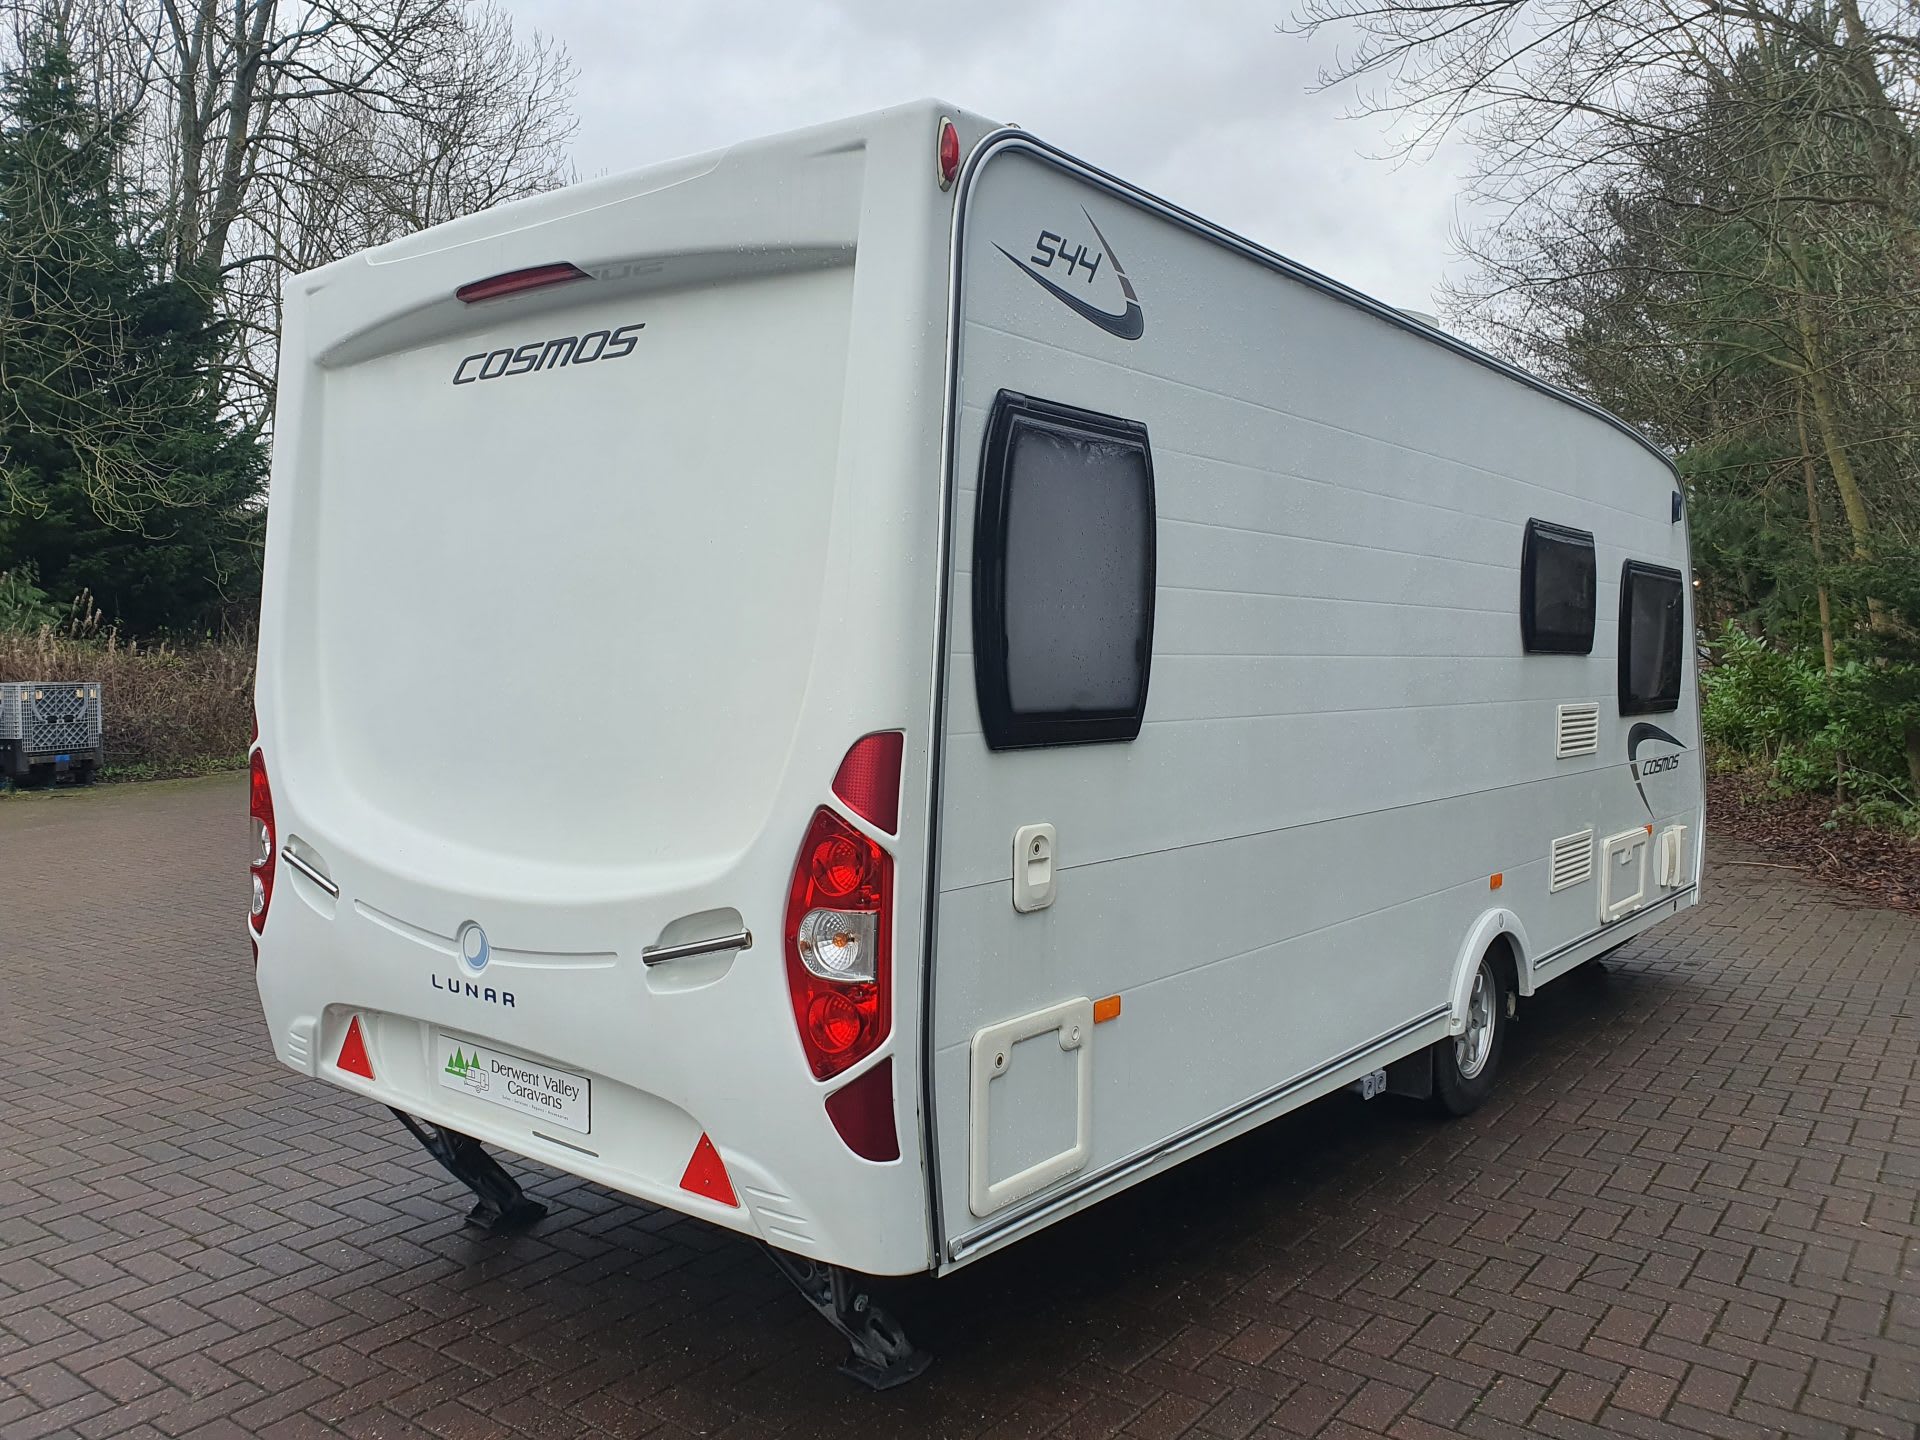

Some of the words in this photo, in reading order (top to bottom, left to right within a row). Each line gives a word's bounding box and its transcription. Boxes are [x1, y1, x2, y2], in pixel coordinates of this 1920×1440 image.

[1030, 229, 1102, 284] 544
[452, 322, 646, 385] COSMOS
[1642, 753, 1680, 776] COSMOS
[431, 973, 516, 1008] LUNAR
[490, 1059, 540, 1087] Derwent
[543, 1075, 580, 1102] Valley
[507, 1080, 563, 1110] Caravans
